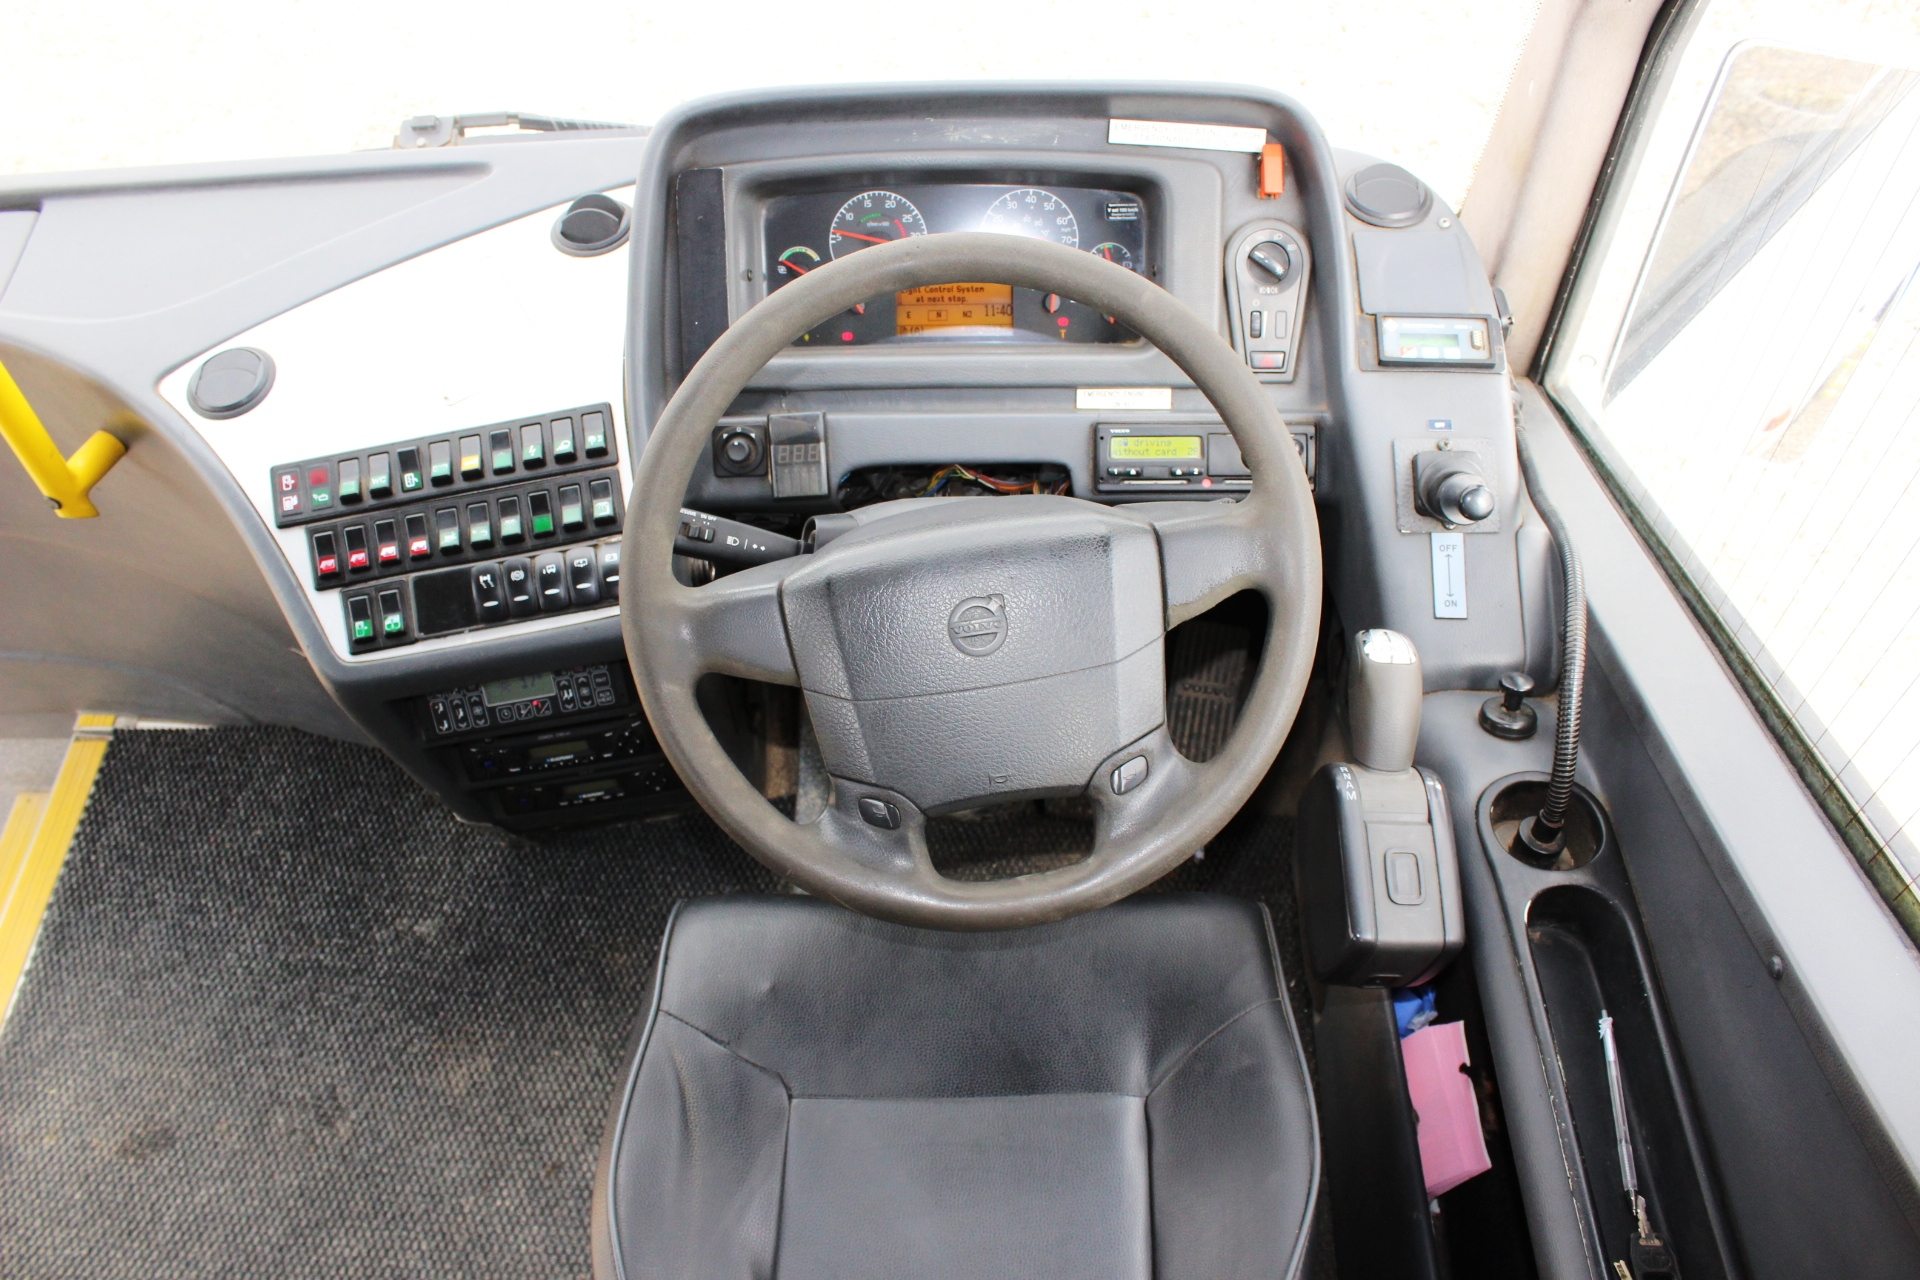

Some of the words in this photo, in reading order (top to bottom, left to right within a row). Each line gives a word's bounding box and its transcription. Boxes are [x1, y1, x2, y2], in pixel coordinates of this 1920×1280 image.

[863, 200, 872, 208] 15
[1025, 195, 1037, 204] 40
[1006, 201, 1018, 209] 30
[1043, 203, 1055, 211] 50
[845, 212, 854, 221] 10
[902, 214, 913, 222] 25
[1056, 216, 1068, 225] 60
[1061, 236, 1072, 244] 70
[984, 304, 1013, 316] 11:40
[1439, 544, 1458, 552] OFF
[1444, 599, 1458, 608] ON
[1345, 780, 1354, 790] A
[1345, 790, 1357, 800] M
